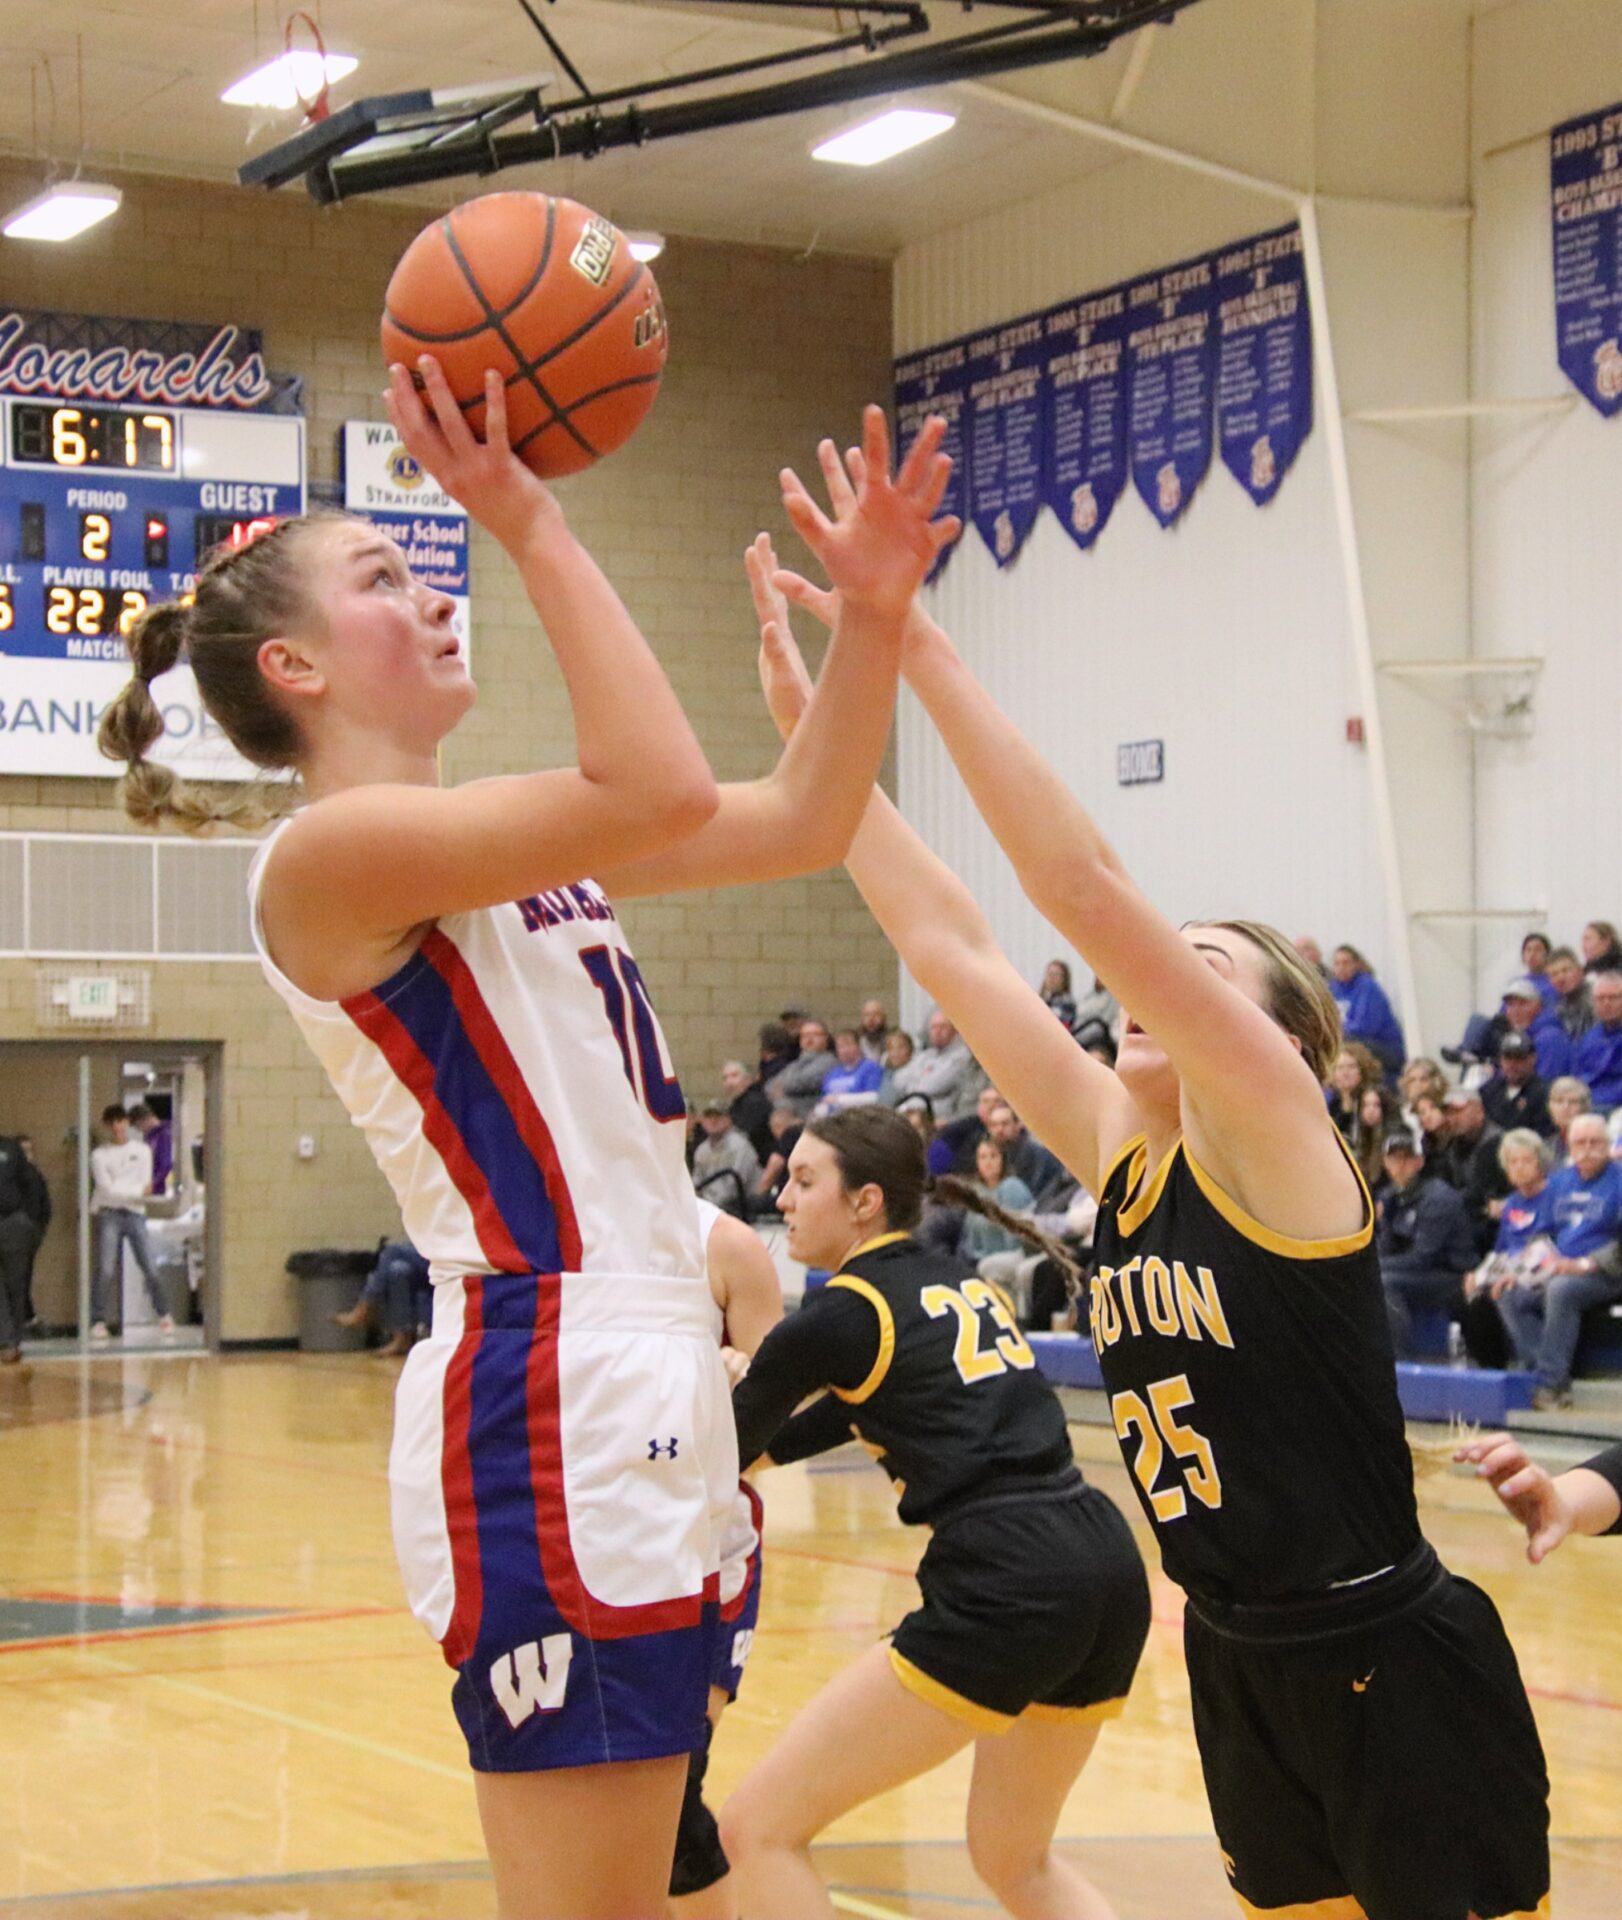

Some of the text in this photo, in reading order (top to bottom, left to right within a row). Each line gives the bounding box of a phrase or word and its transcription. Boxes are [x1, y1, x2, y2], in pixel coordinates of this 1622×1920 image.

[52, 409, 172, 468] 6:17
[67, 489, 127, 511] PERIOD
[200, 483, 278, 511] GUEST
[366, 485, 450, 507] STRATFORD
[83, 514, 110, 561] 2
[413, 519, 465, 544] School
[406, 541, 456, 568] dation
[43, 565, 151, 589] PLAYER FOUL
[67, 638, 126, 659] MATCH
[578, 944, 687, 1124] 10
[921, 1278, 1036, 1385] 23
[1112, 1373, 1223, 1523] 25
[490, 1632, 573, 1729] W
